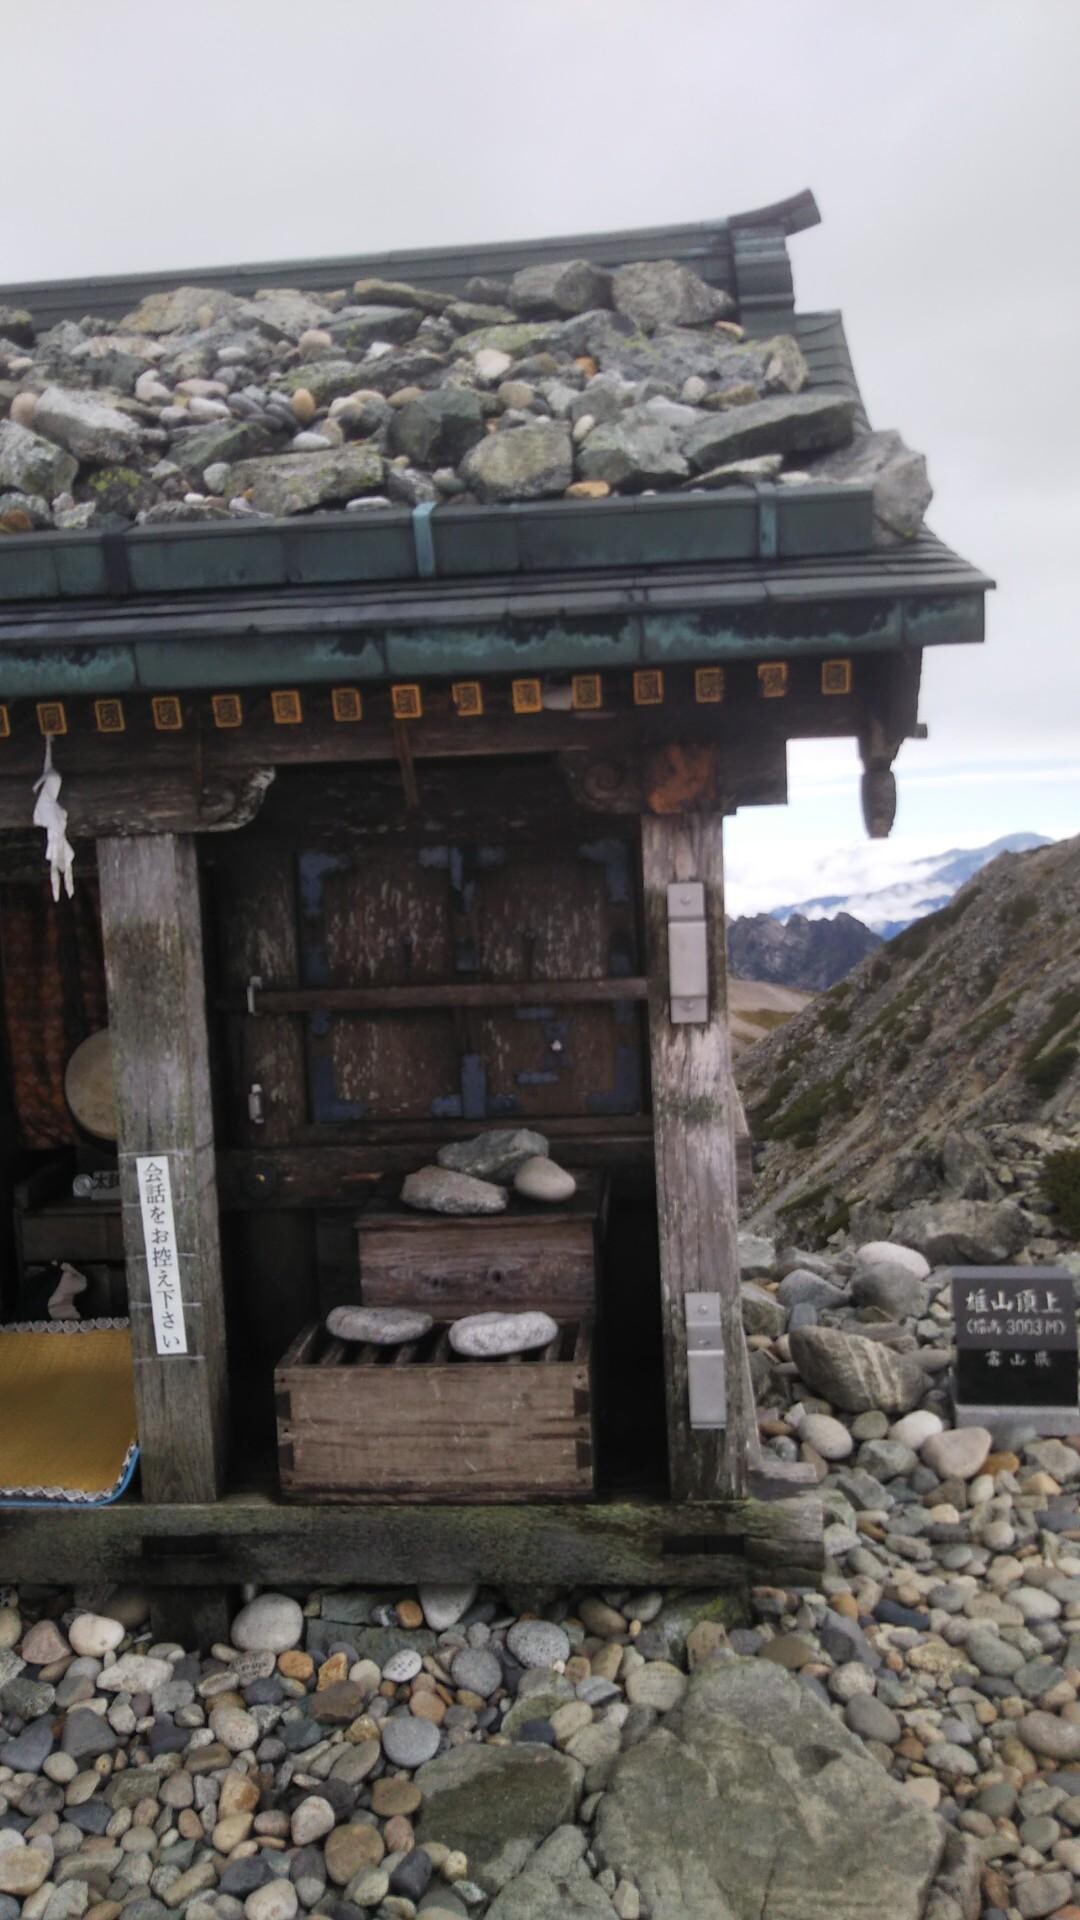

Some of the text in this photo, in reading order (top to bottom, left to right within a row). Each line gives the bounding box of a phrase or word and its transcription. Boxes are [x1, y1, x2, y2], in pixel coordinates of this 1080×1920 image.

[144, 1162, 180, 1348] 会話をお控え下さい
[965, 1288, 1063, 1313] 雄山頂上
[986, 1349, 1050, 1367] 富山県
